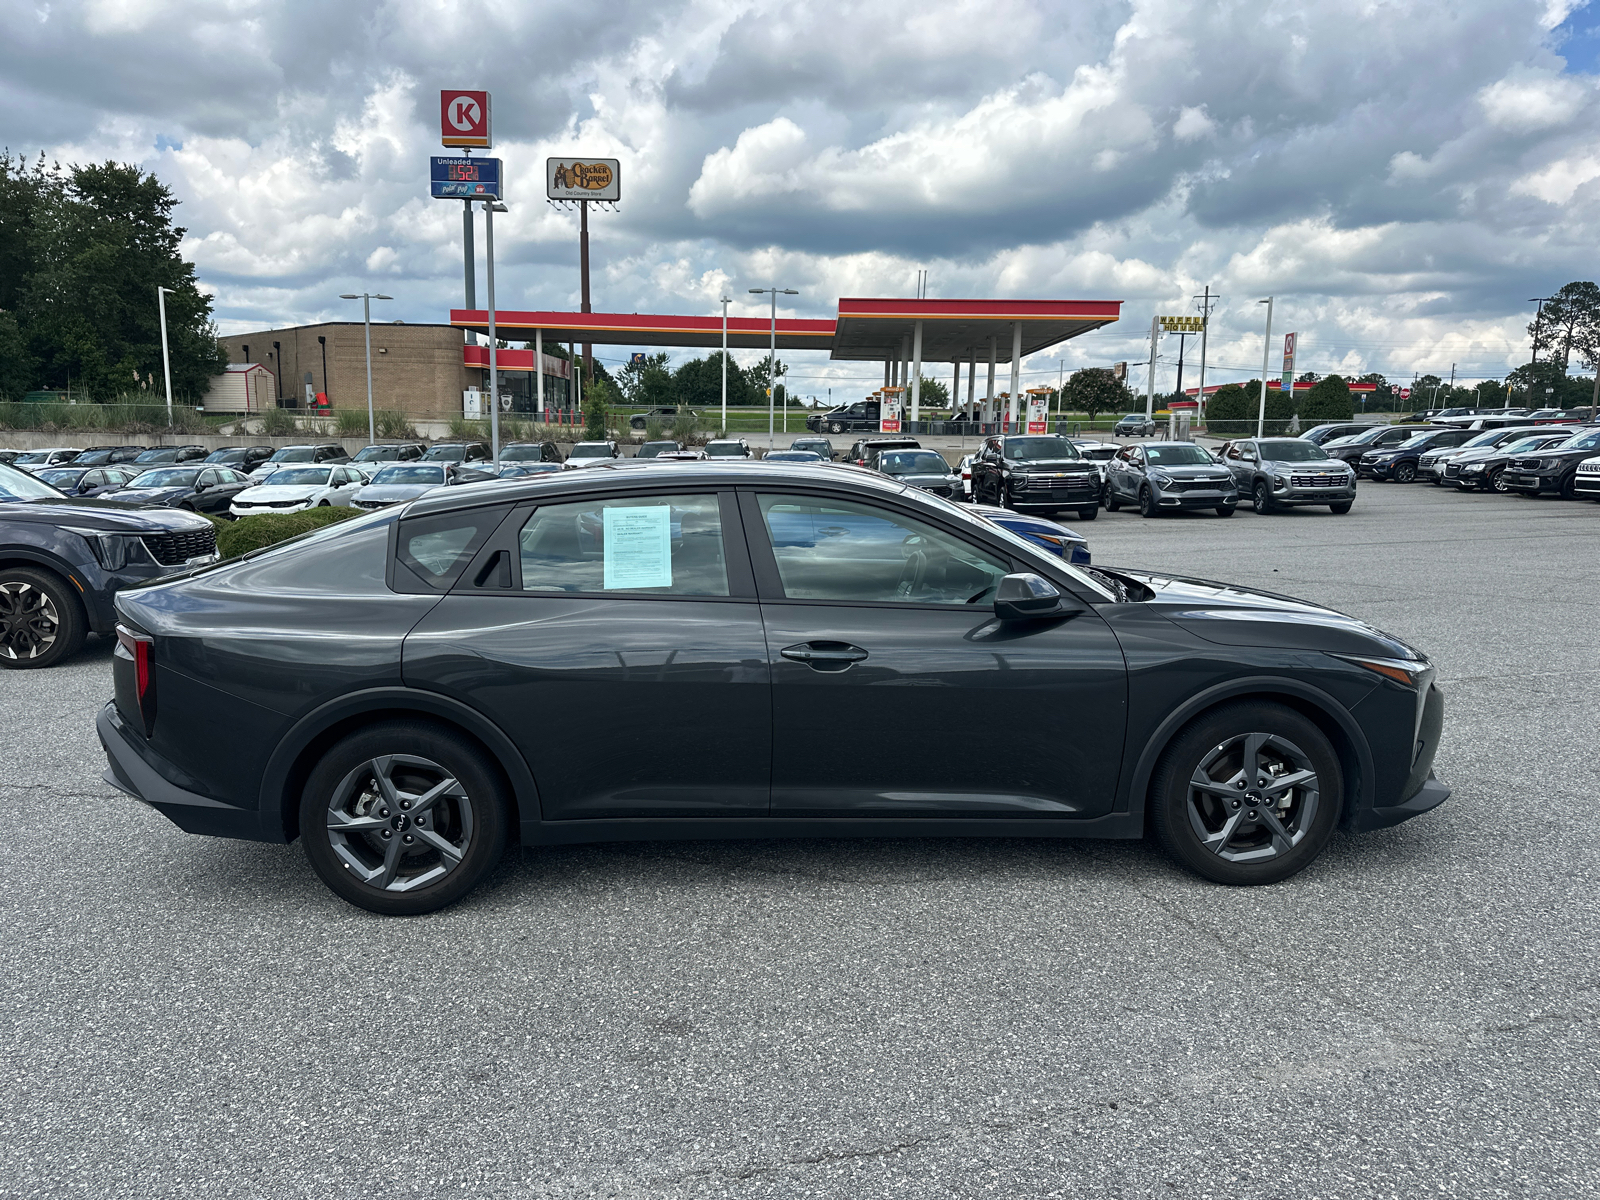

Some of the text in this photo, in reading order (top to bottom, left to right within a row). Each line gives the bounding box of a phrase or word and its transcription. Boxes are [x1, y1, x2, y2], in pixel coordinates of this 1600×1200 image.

[456, 103, 479, 130] K
[437, 158, 472, 166] Unleaded
[572, 163, 608, 177] Cracker
[580, 173, 609, 188] Barrel
[442, 184, 457, 194] Polar
[457, 186, 469, 194] Pop
[1160, 316, 1208, 324] WAFFL
